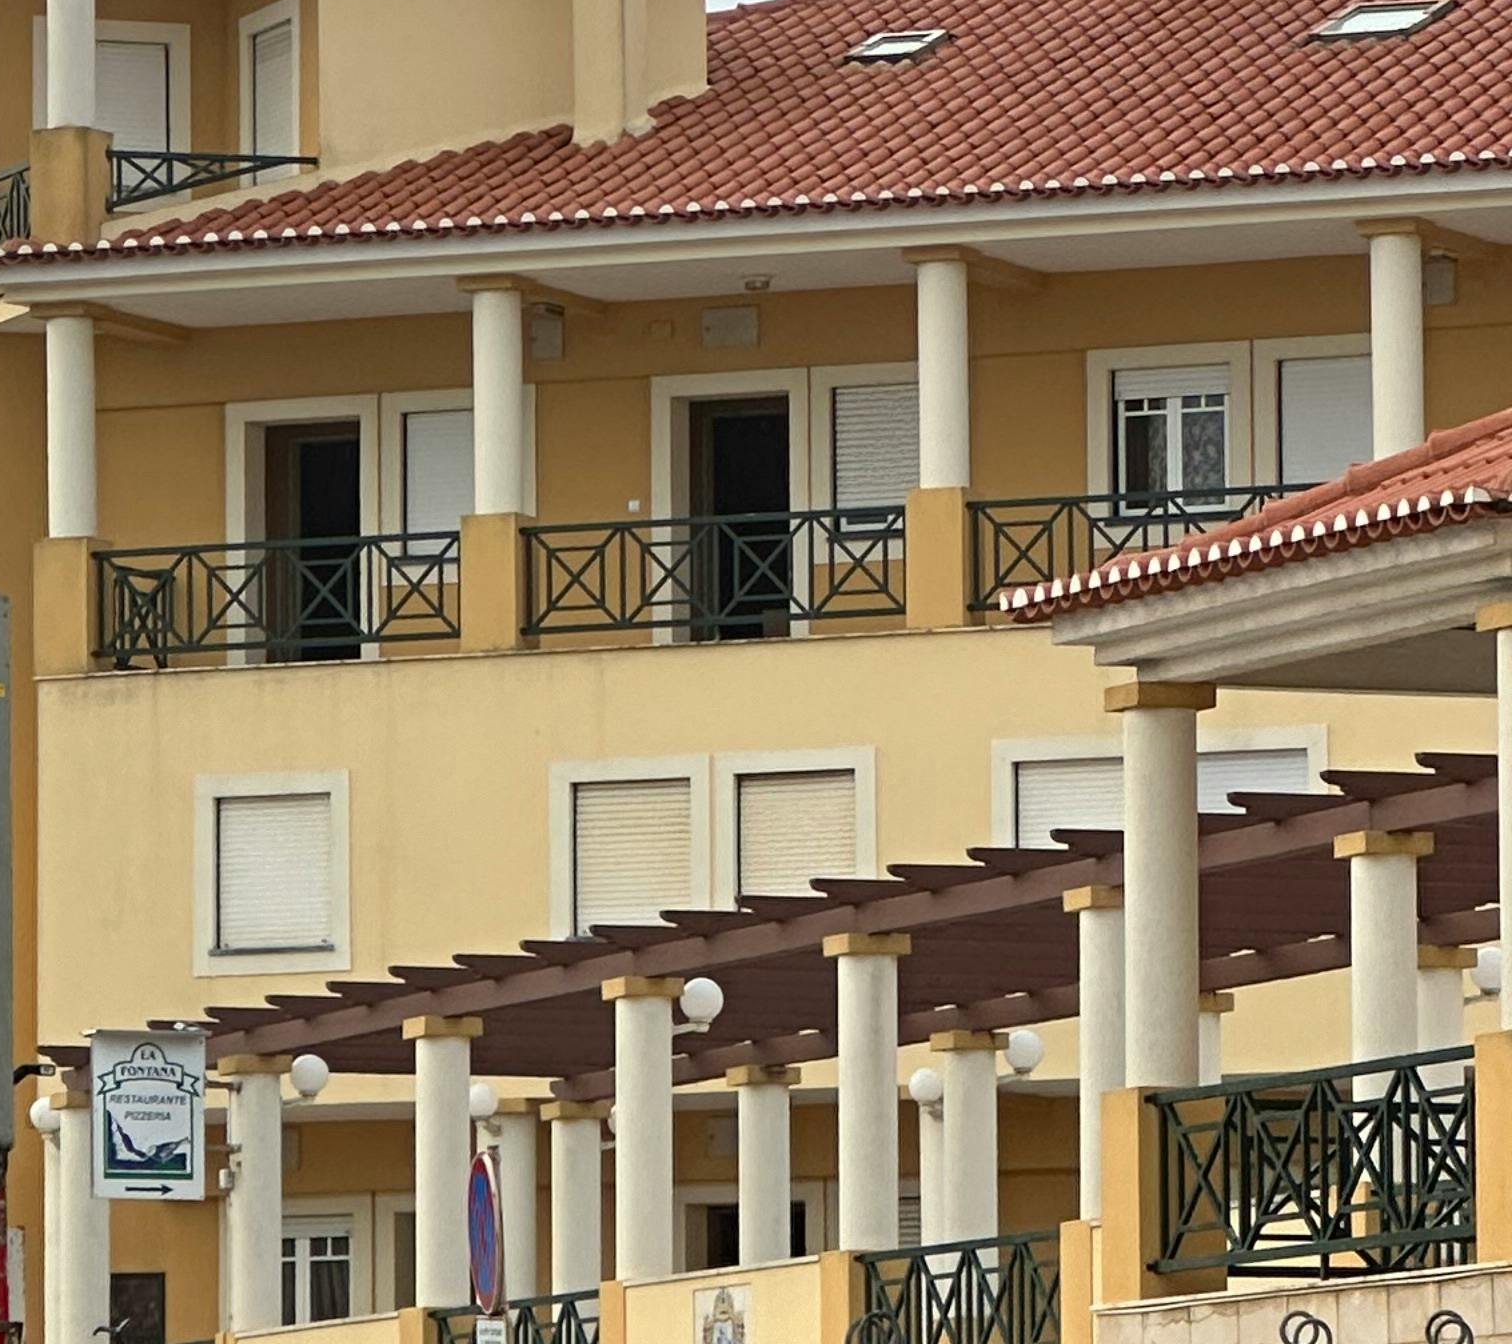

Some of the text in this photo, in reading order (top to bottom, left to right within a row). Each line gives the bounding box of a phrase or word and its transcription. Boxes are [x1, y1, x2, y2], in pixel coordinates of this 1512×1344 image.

[140, 1050, 156, 1060] LA
[120, 1065, 176, 1077] FONTANA
[109, 1094, 187, 1105] RESTAURANTE
